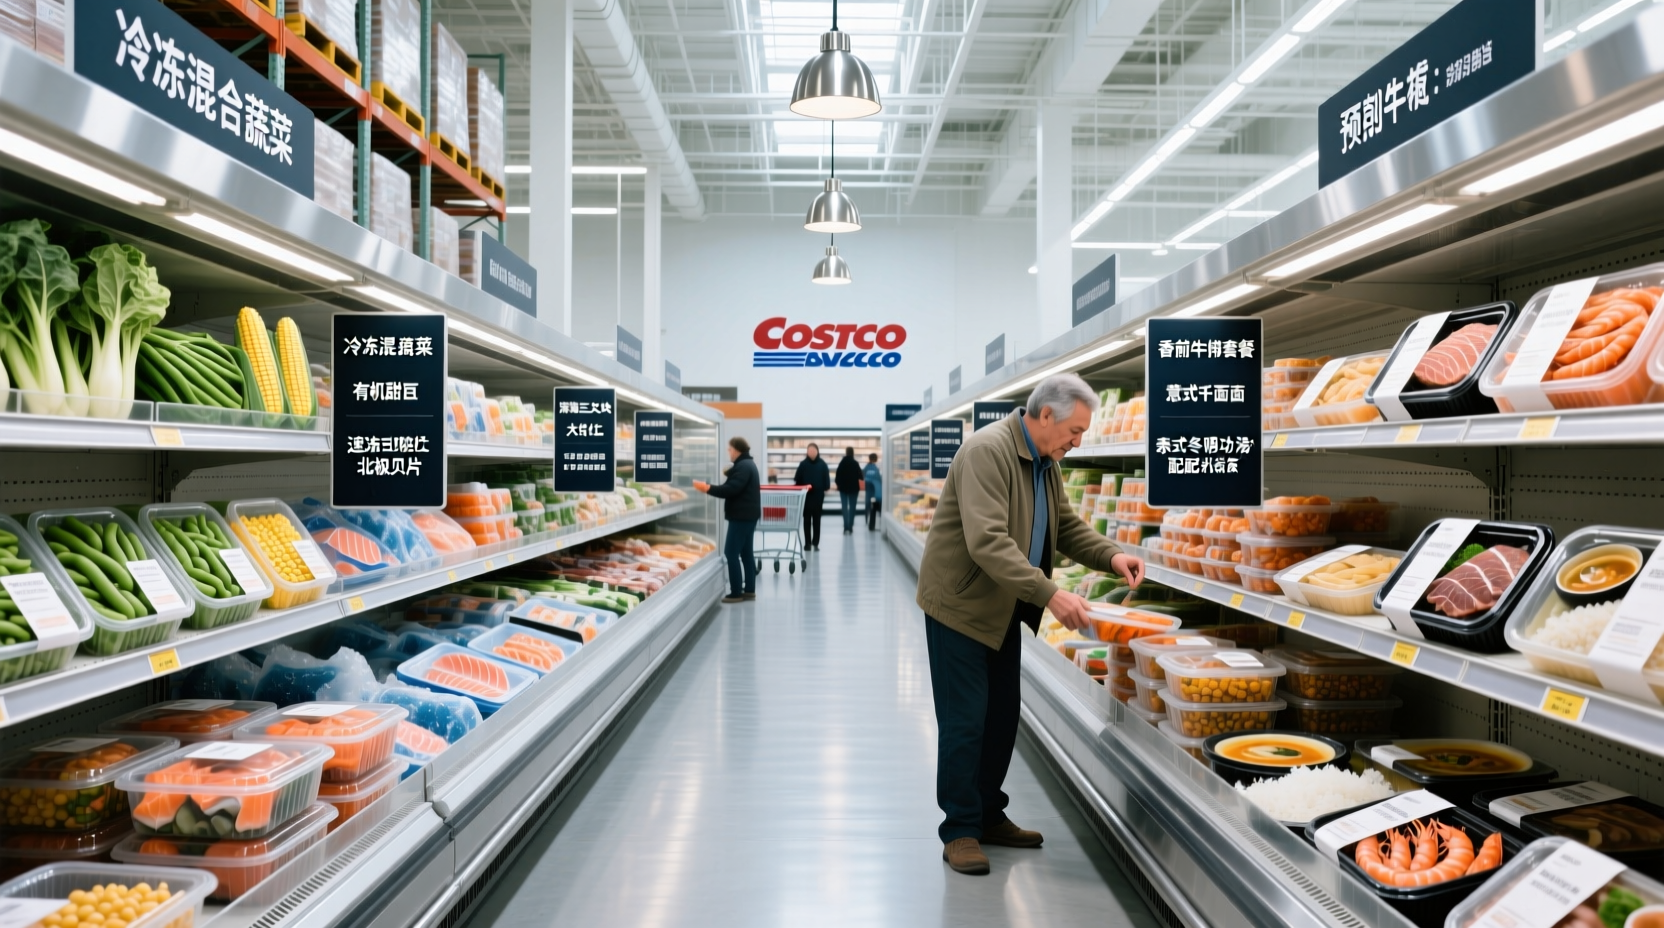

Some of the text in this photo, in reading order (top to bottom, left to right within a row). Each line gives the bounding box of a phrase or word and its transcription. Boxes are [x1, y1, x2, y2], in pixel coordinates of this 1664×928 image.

[115, 8, 293, 166] 冷冻混合蔬菜
